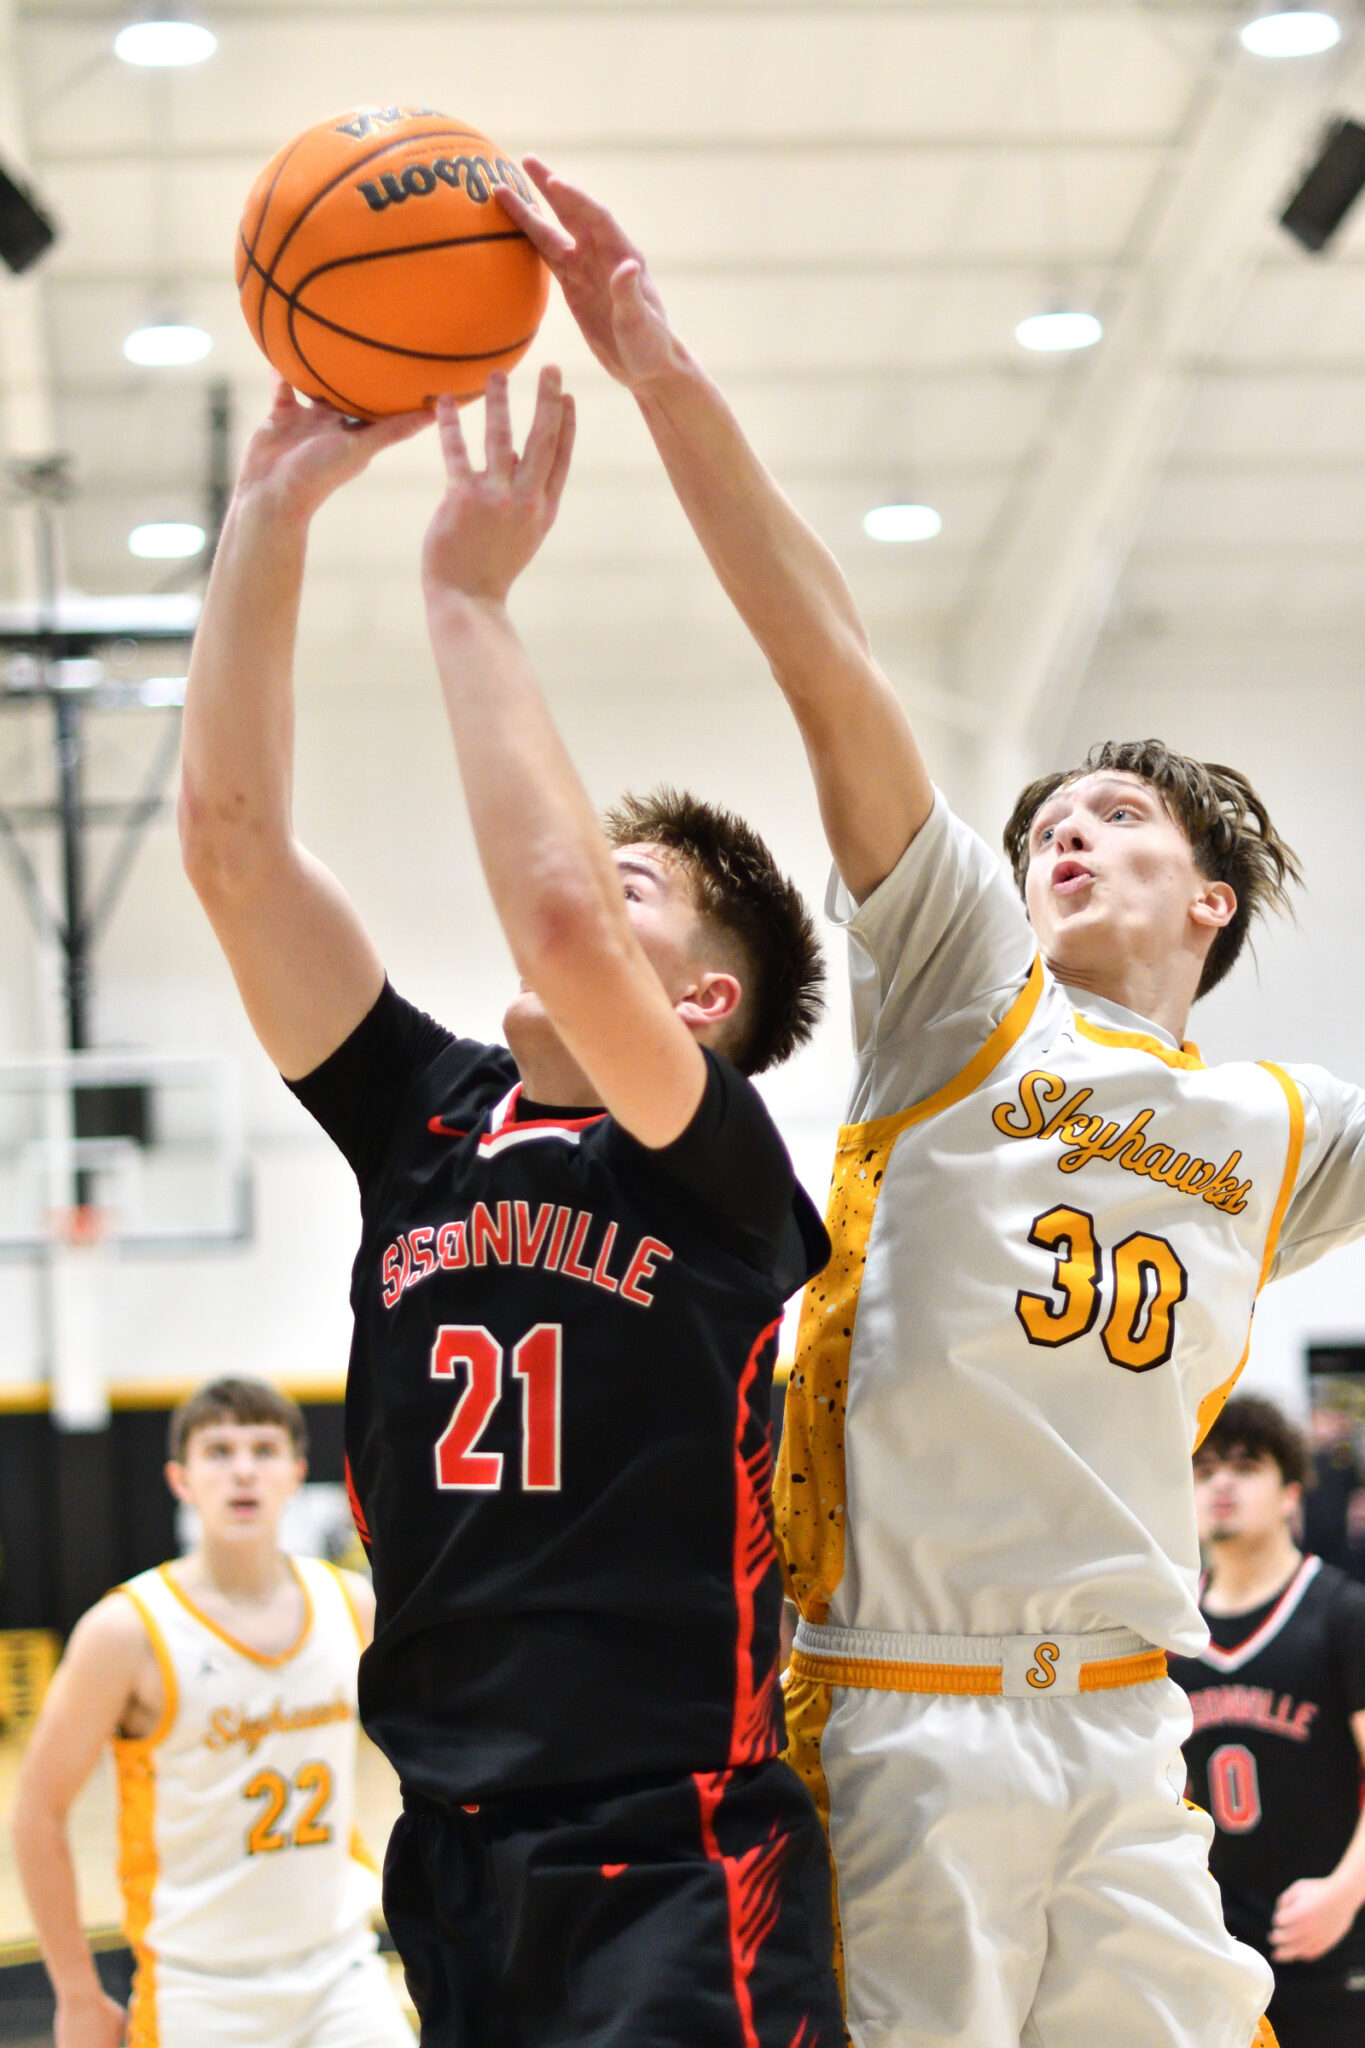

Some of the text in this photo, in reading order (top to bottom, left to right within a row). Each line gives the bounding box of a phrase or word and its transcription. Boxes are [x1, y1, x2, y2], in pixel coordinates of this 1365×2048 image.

[991, 1069, 1252, 1215] Skyhawks
[1014, 1203, 1188, 1373] 30
[430, 1322, 563, 1491] 21
[1025, 1641, 1060, 1689] S
[243, 1760, 333, 1855] 22
[1207, 1743, 1262, 1834] 0
